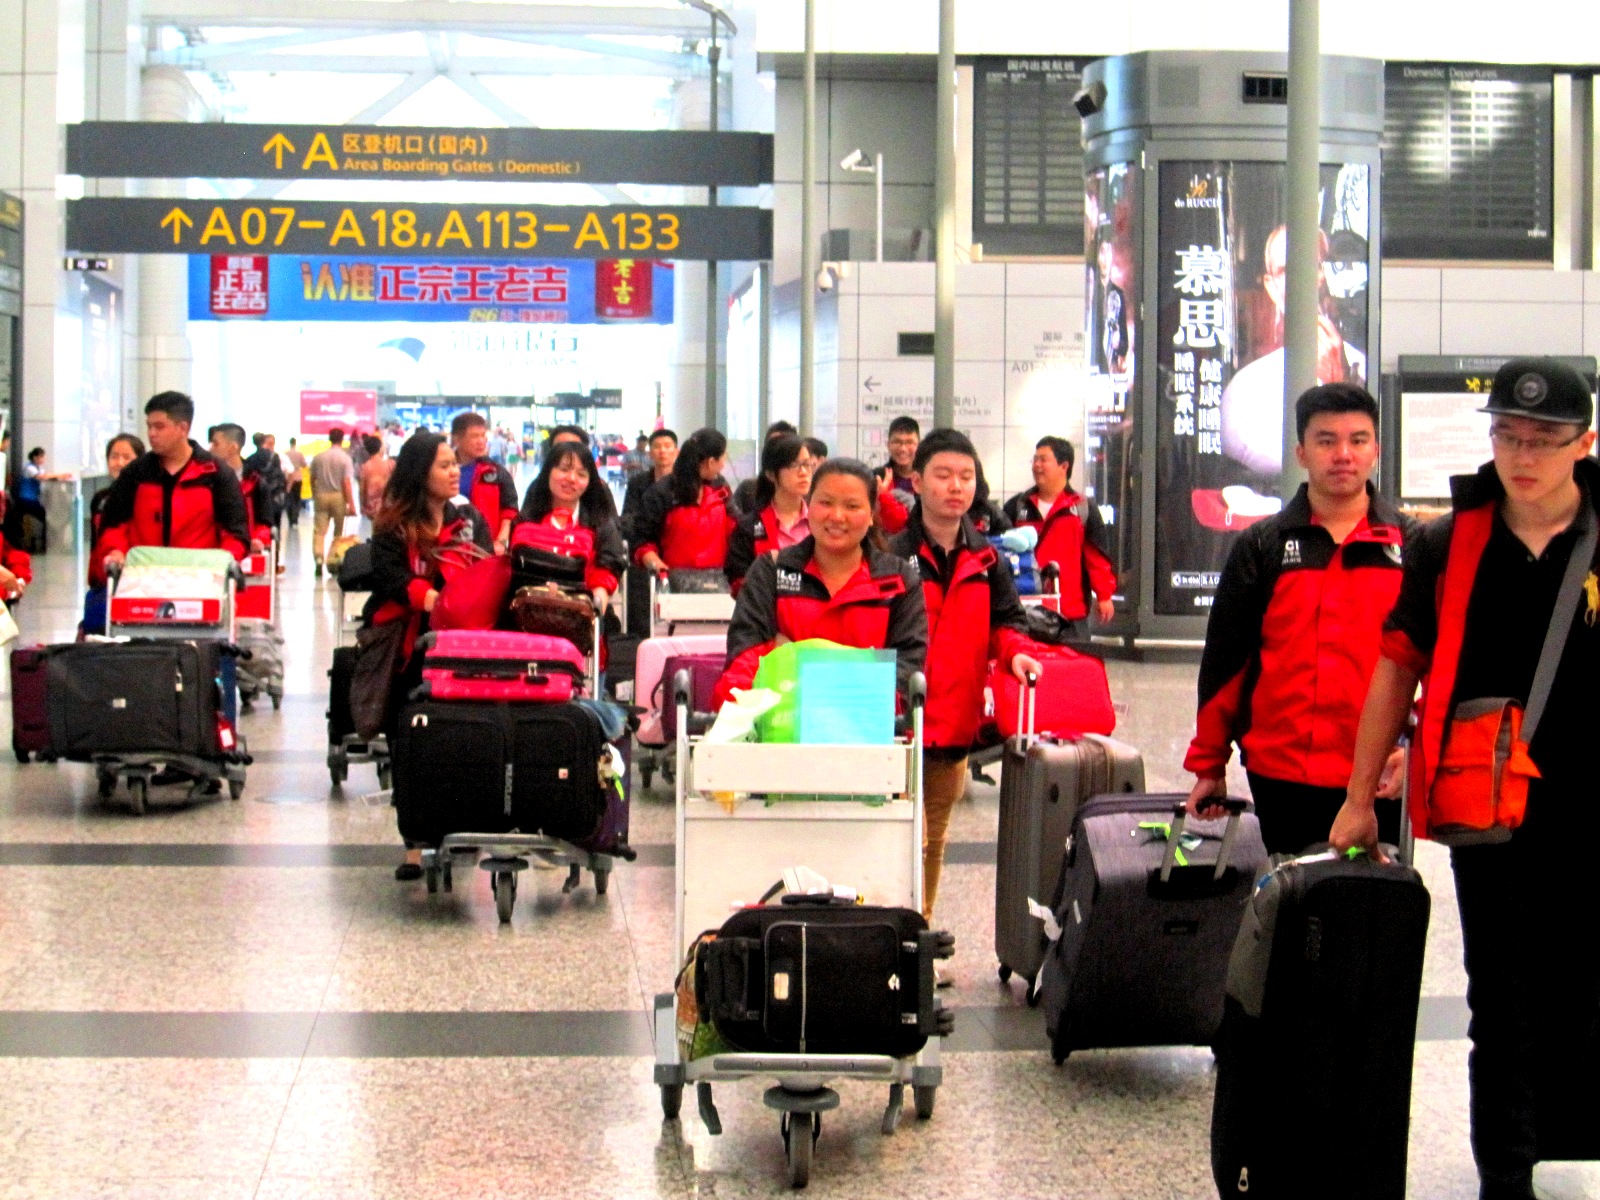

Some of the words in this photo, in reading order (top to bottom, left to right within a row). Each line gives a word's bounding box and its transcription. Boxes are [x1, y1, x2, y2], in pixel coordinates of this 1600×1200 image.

[302, 132, 339, 171] A
[343, 157, 379, 172] Area
[382, 157, 449, 176] Boarding
[452, 159, 494, 173] Gates
[217, 269, 263, 291] 正宗
[212, 290, 267, 310] 王老吉
[1173, 244, 1229, 348] 慕思
